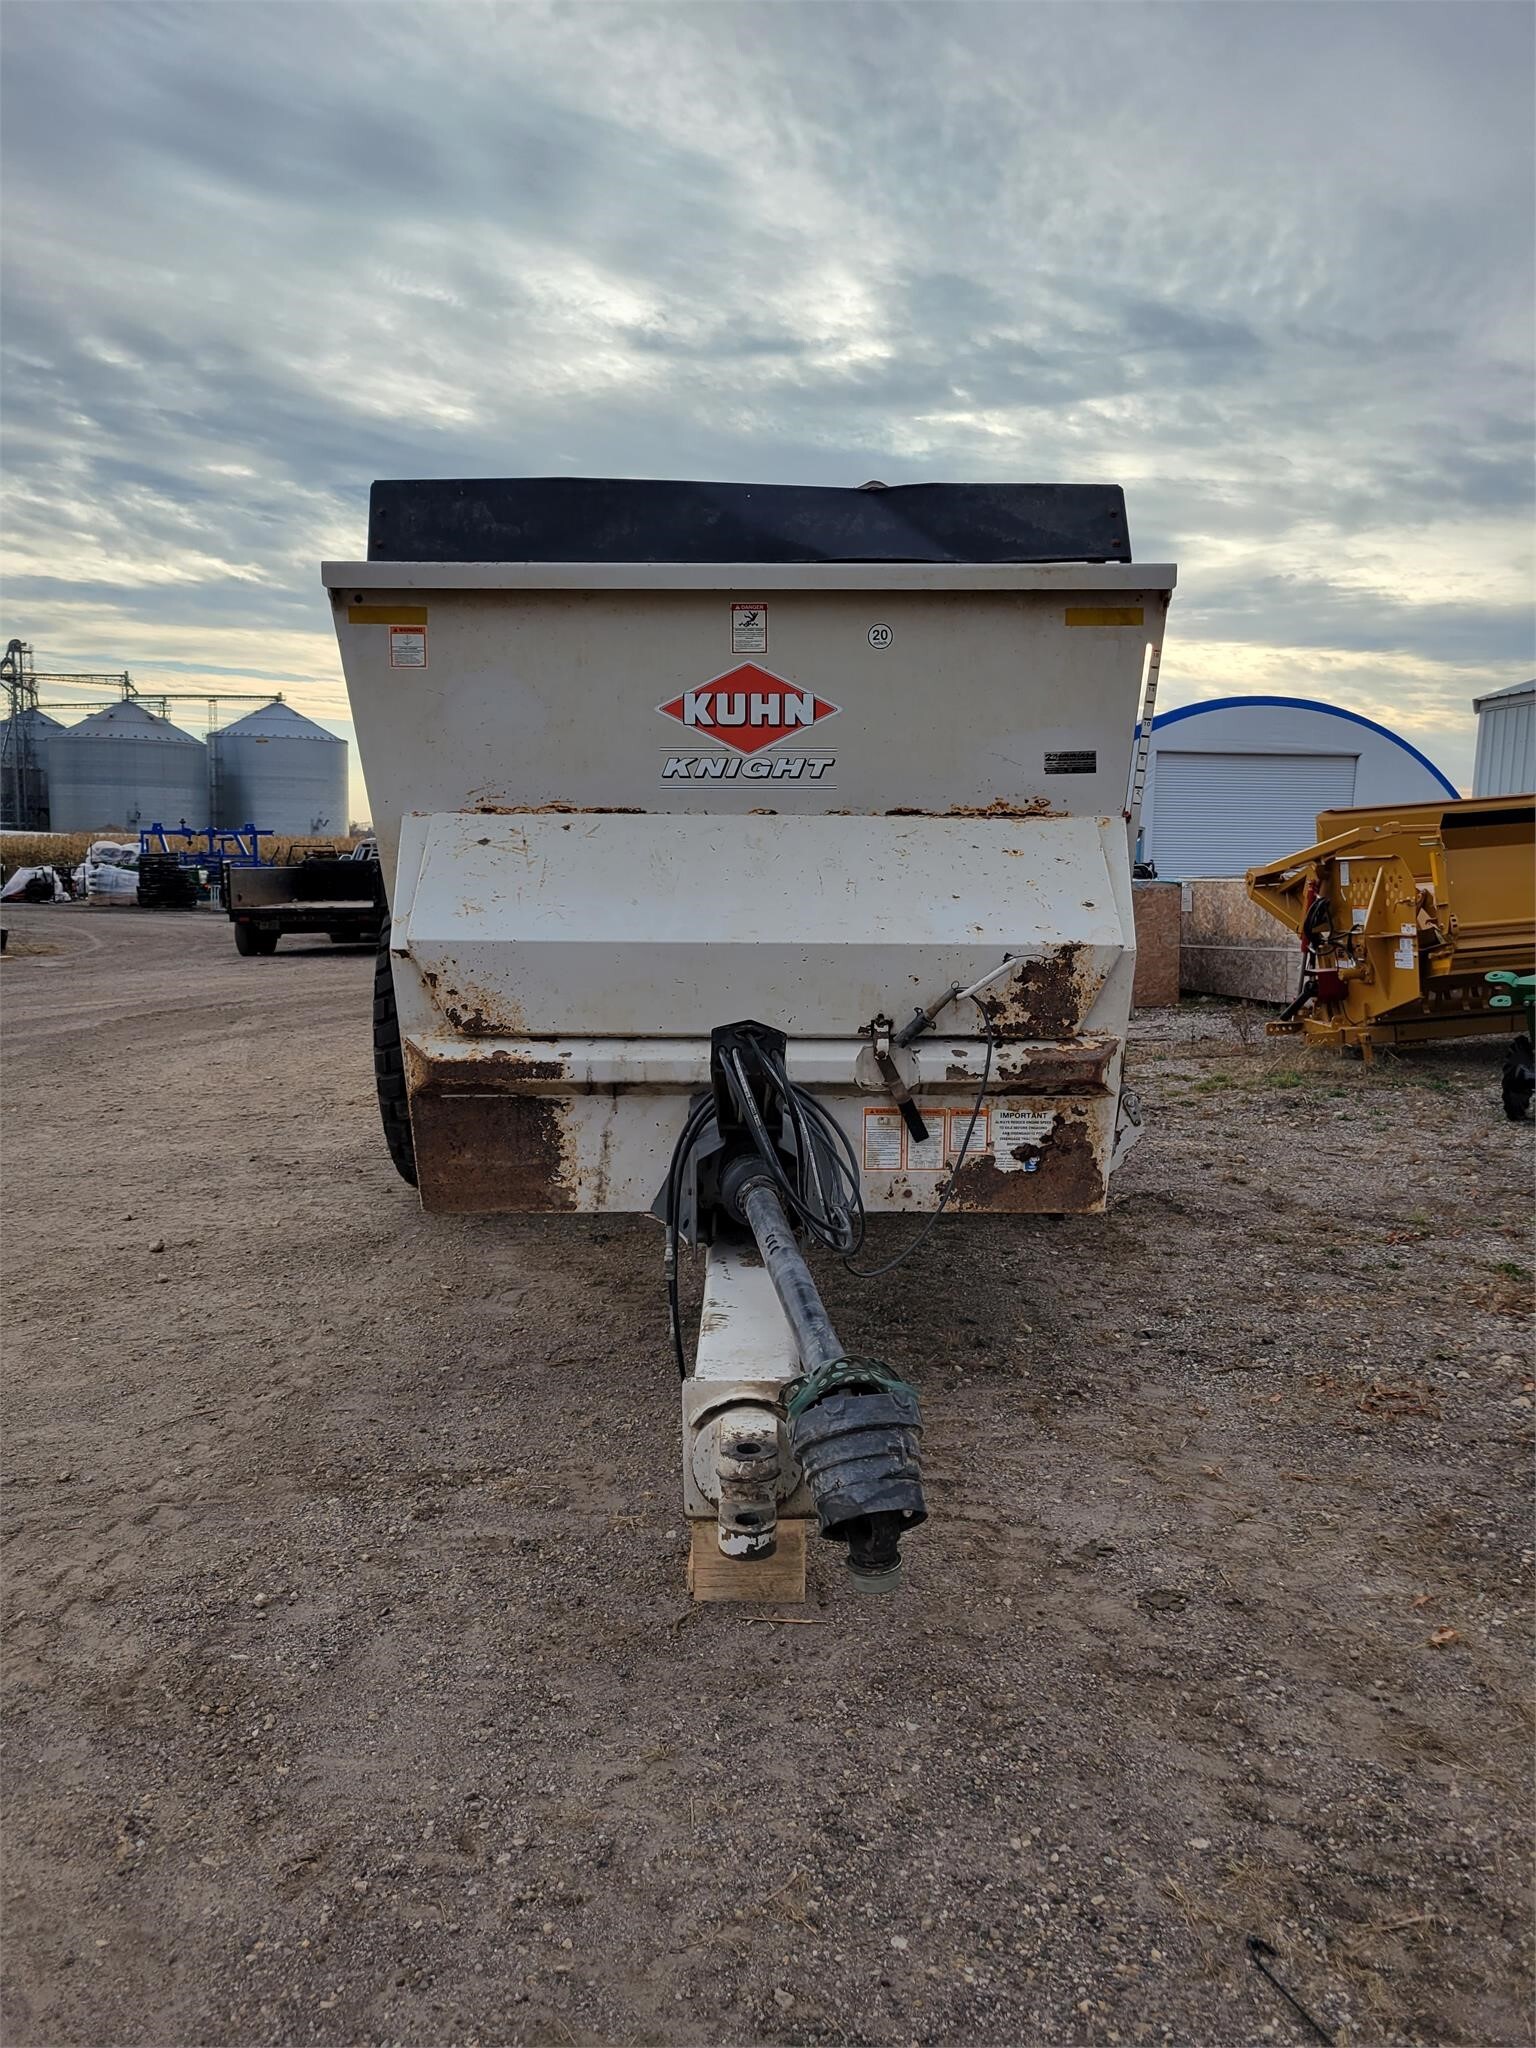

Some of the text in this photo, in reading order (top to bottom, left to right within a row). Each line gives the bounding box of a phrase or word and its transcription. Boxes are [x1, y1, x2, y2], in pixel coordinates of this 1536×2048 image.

[872, 629, 888, 640] 20
[682, 692, 815, 727] KUHN
[661, 757, 836, 779] KNIGHT
